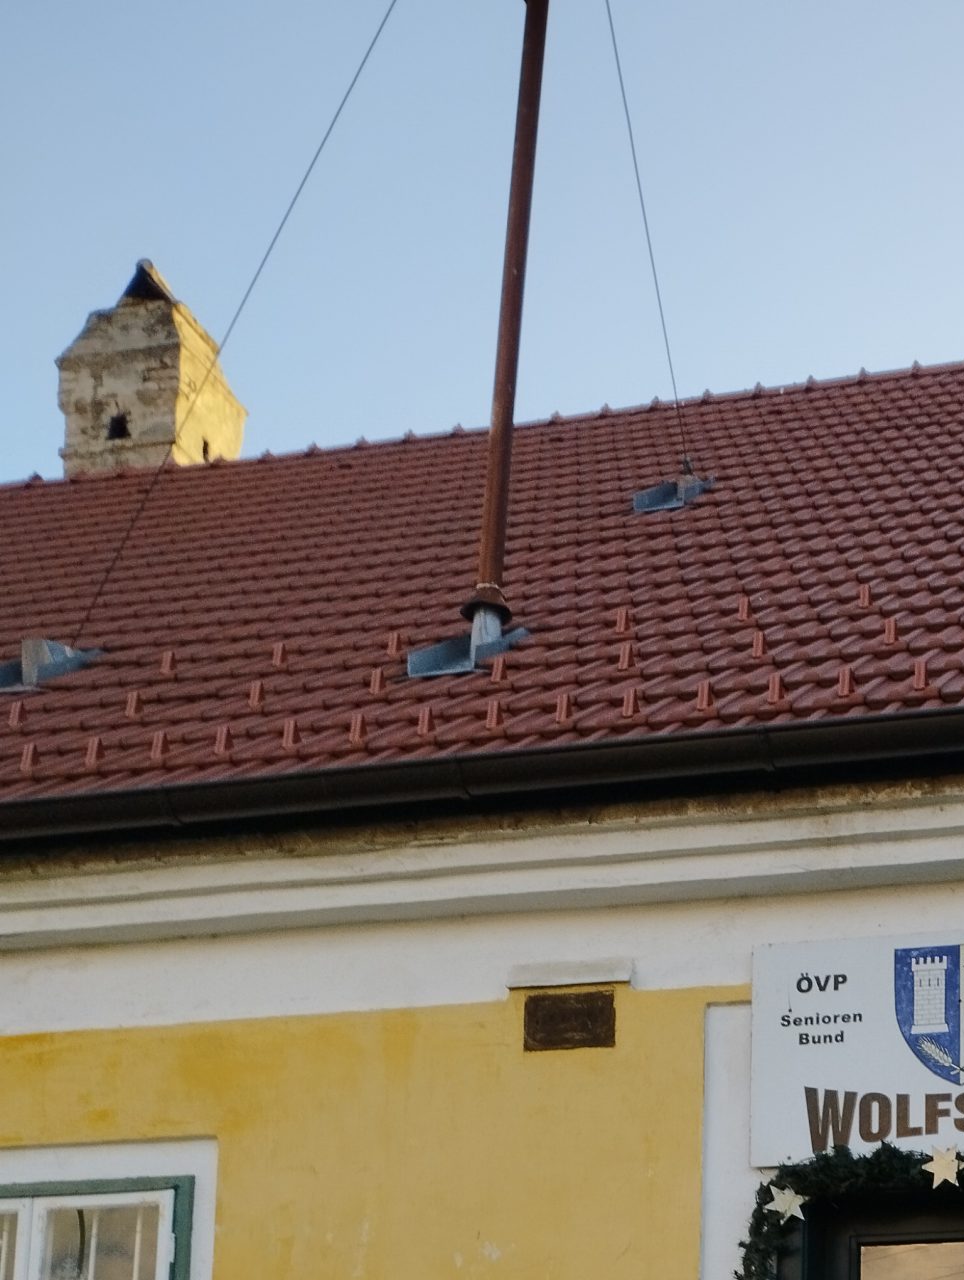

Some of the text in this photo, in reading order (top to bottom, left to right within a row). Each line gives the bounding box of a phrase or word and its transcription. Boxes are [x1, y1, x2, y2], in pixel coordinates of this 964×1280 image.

[796, 972, 848, 994] ÖVP
[780, 1012, 863, 1027] Senioren
[798, 1030, 845, 1045] Bund
